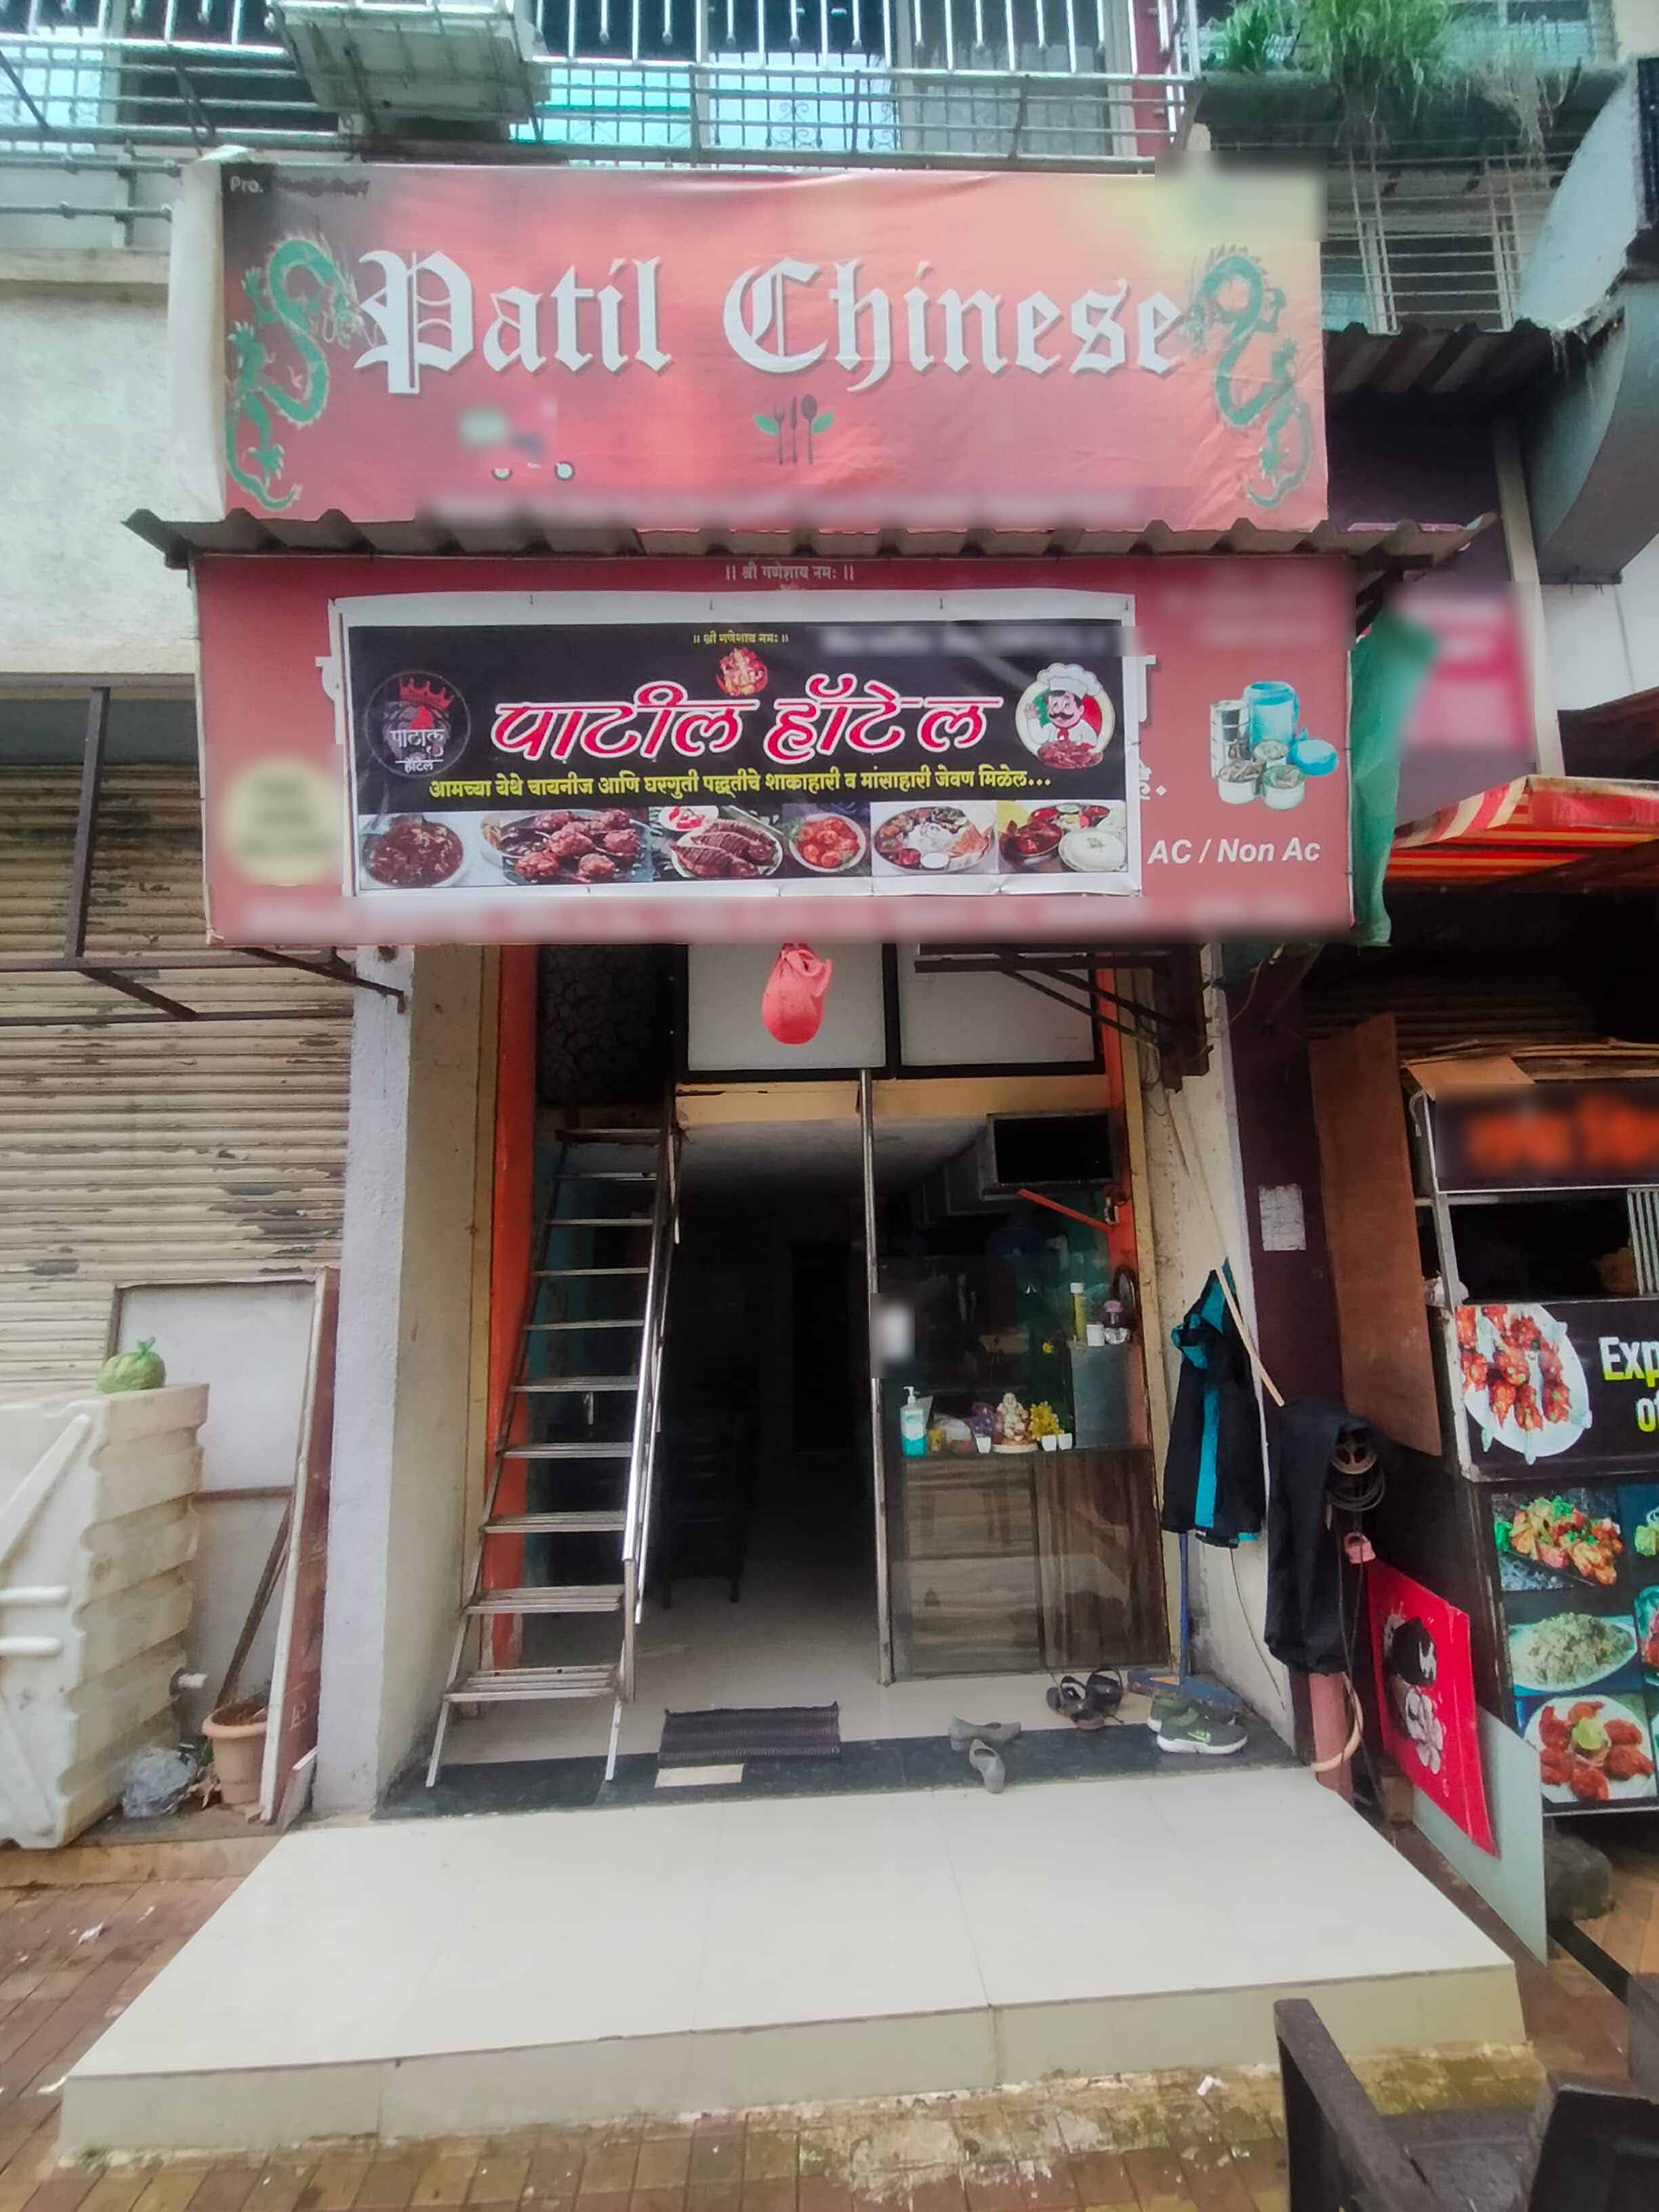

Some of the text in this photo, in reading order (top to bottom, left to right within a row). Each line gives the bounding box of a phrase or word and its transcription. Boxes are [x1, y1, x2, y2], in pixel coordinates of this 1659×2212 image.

[230, 176, 264, 193] Pro.
[353, 249, 1185, 396] Patil Chinese
[491, 673, 1002, 765] पाटील हॉटेल
[495, 772, 524, 796] येथे
[527, 771, 594, 796] चायनीज
[598, 770, 640, 794] आणि
[643, 769, 699, 800] घरगुती
[765, 765, 841, 794] शाकाहारी
[844, 773, 857, 790] व
[860, 764, 932, 792] मांसाहारी
[935, 764, 975, 787] जेवण
[1147, 836, 1322, 864] AC / Non Ac
